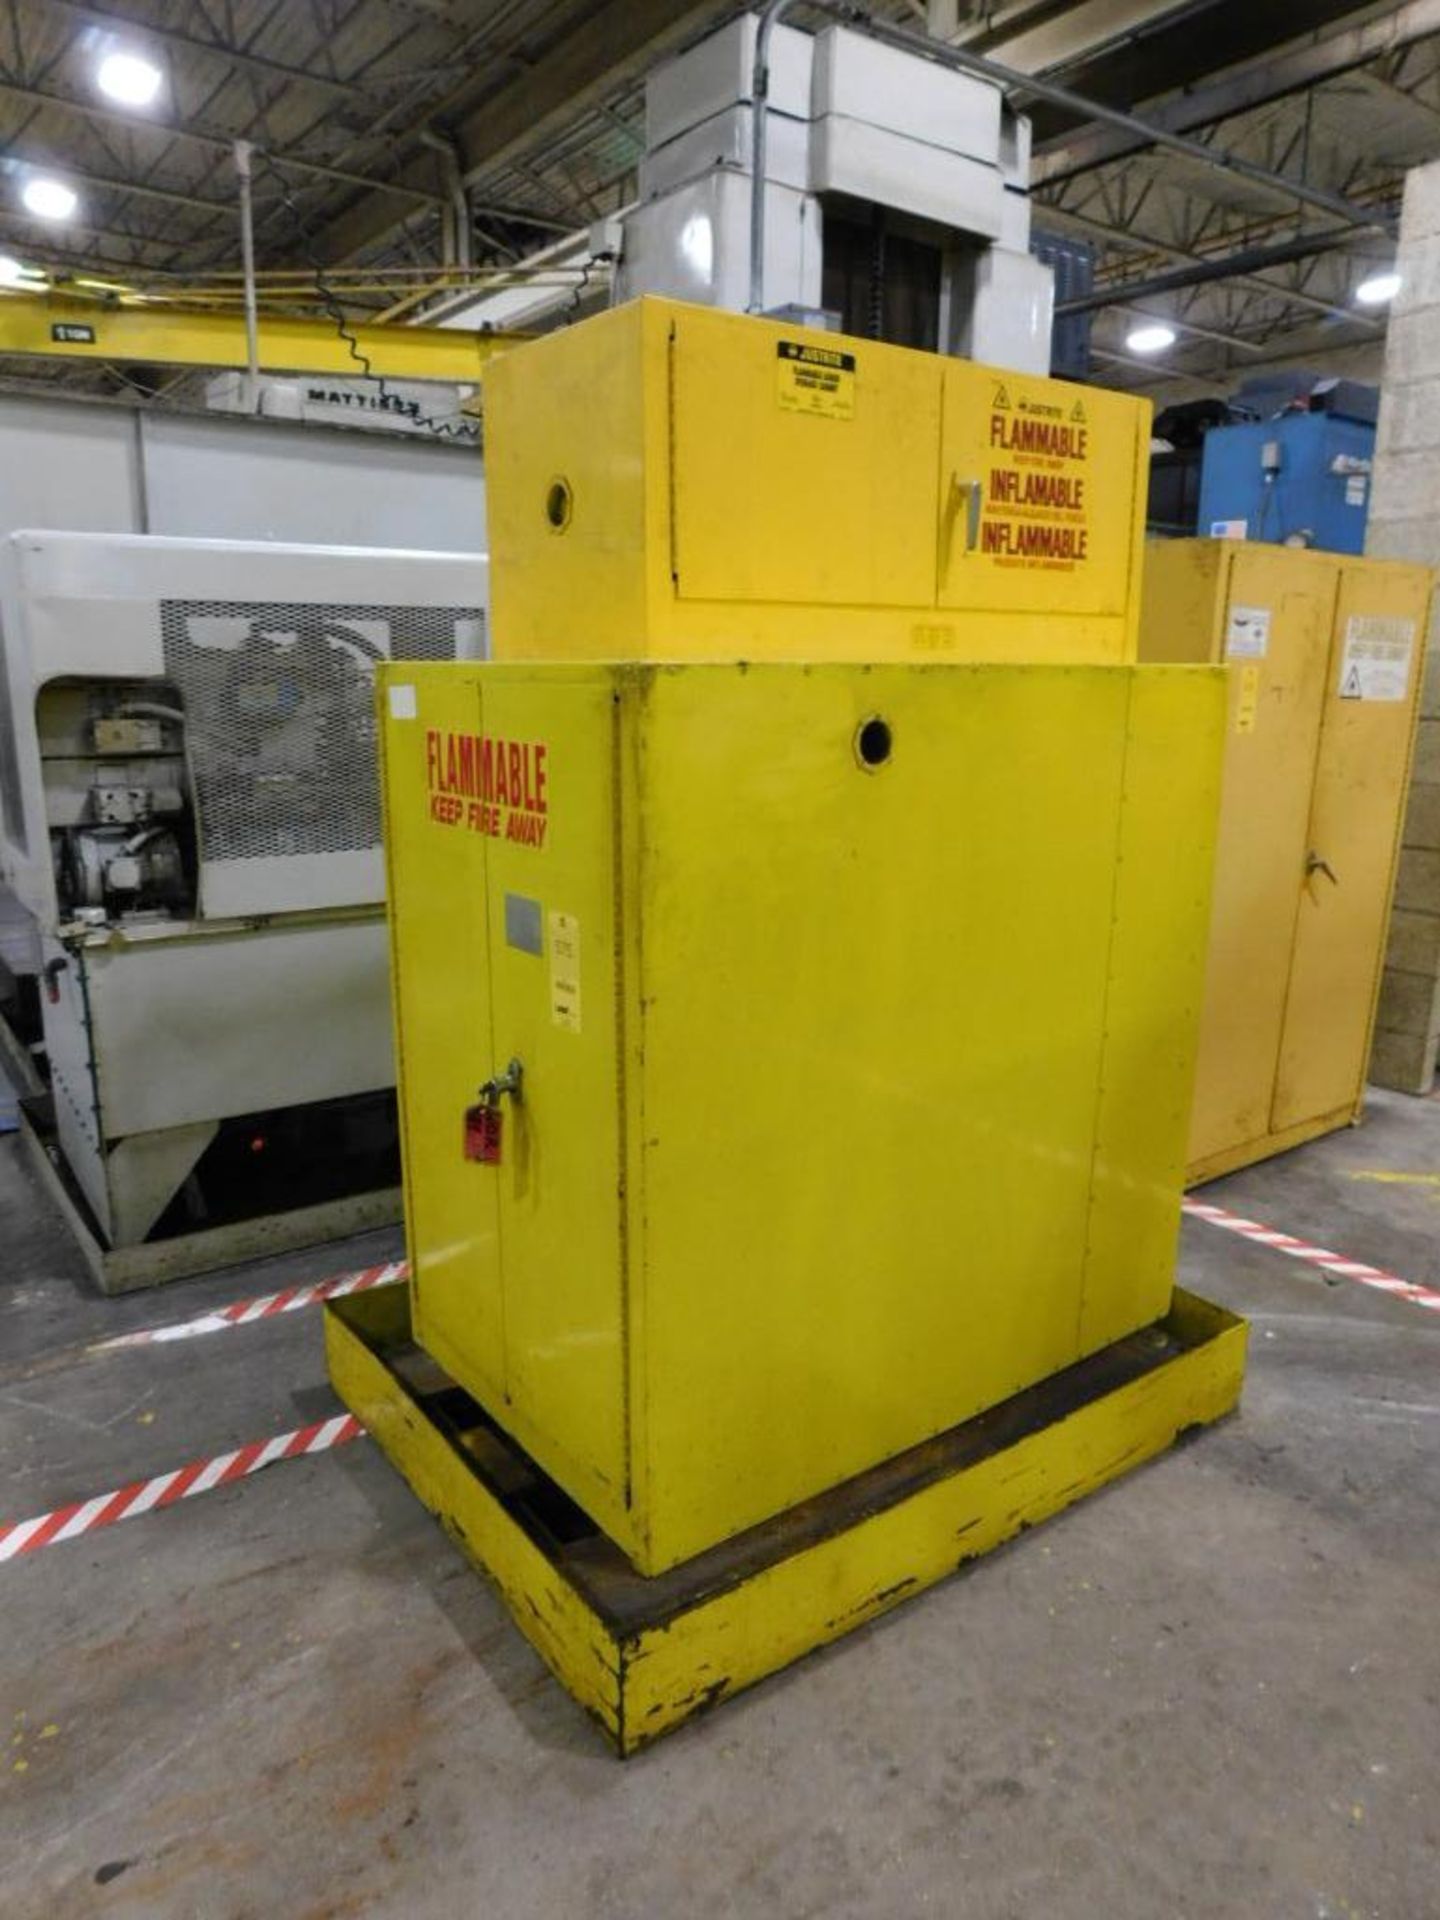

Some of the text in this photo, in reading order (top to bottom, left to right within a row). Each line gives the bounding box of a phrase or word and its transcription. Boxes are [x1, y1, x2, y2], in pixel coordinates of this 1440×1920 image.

[990, 414, 1087, 460] FLAMMABLE
[990, 469, 1084, 510] INFLAMABLE
[981, 522, 1088, 560] INFLAMMABLE
[427, 730, 546, 814] FLAMMABLE
[431, 795, 547, 849] KEEP FIRE AWAY
